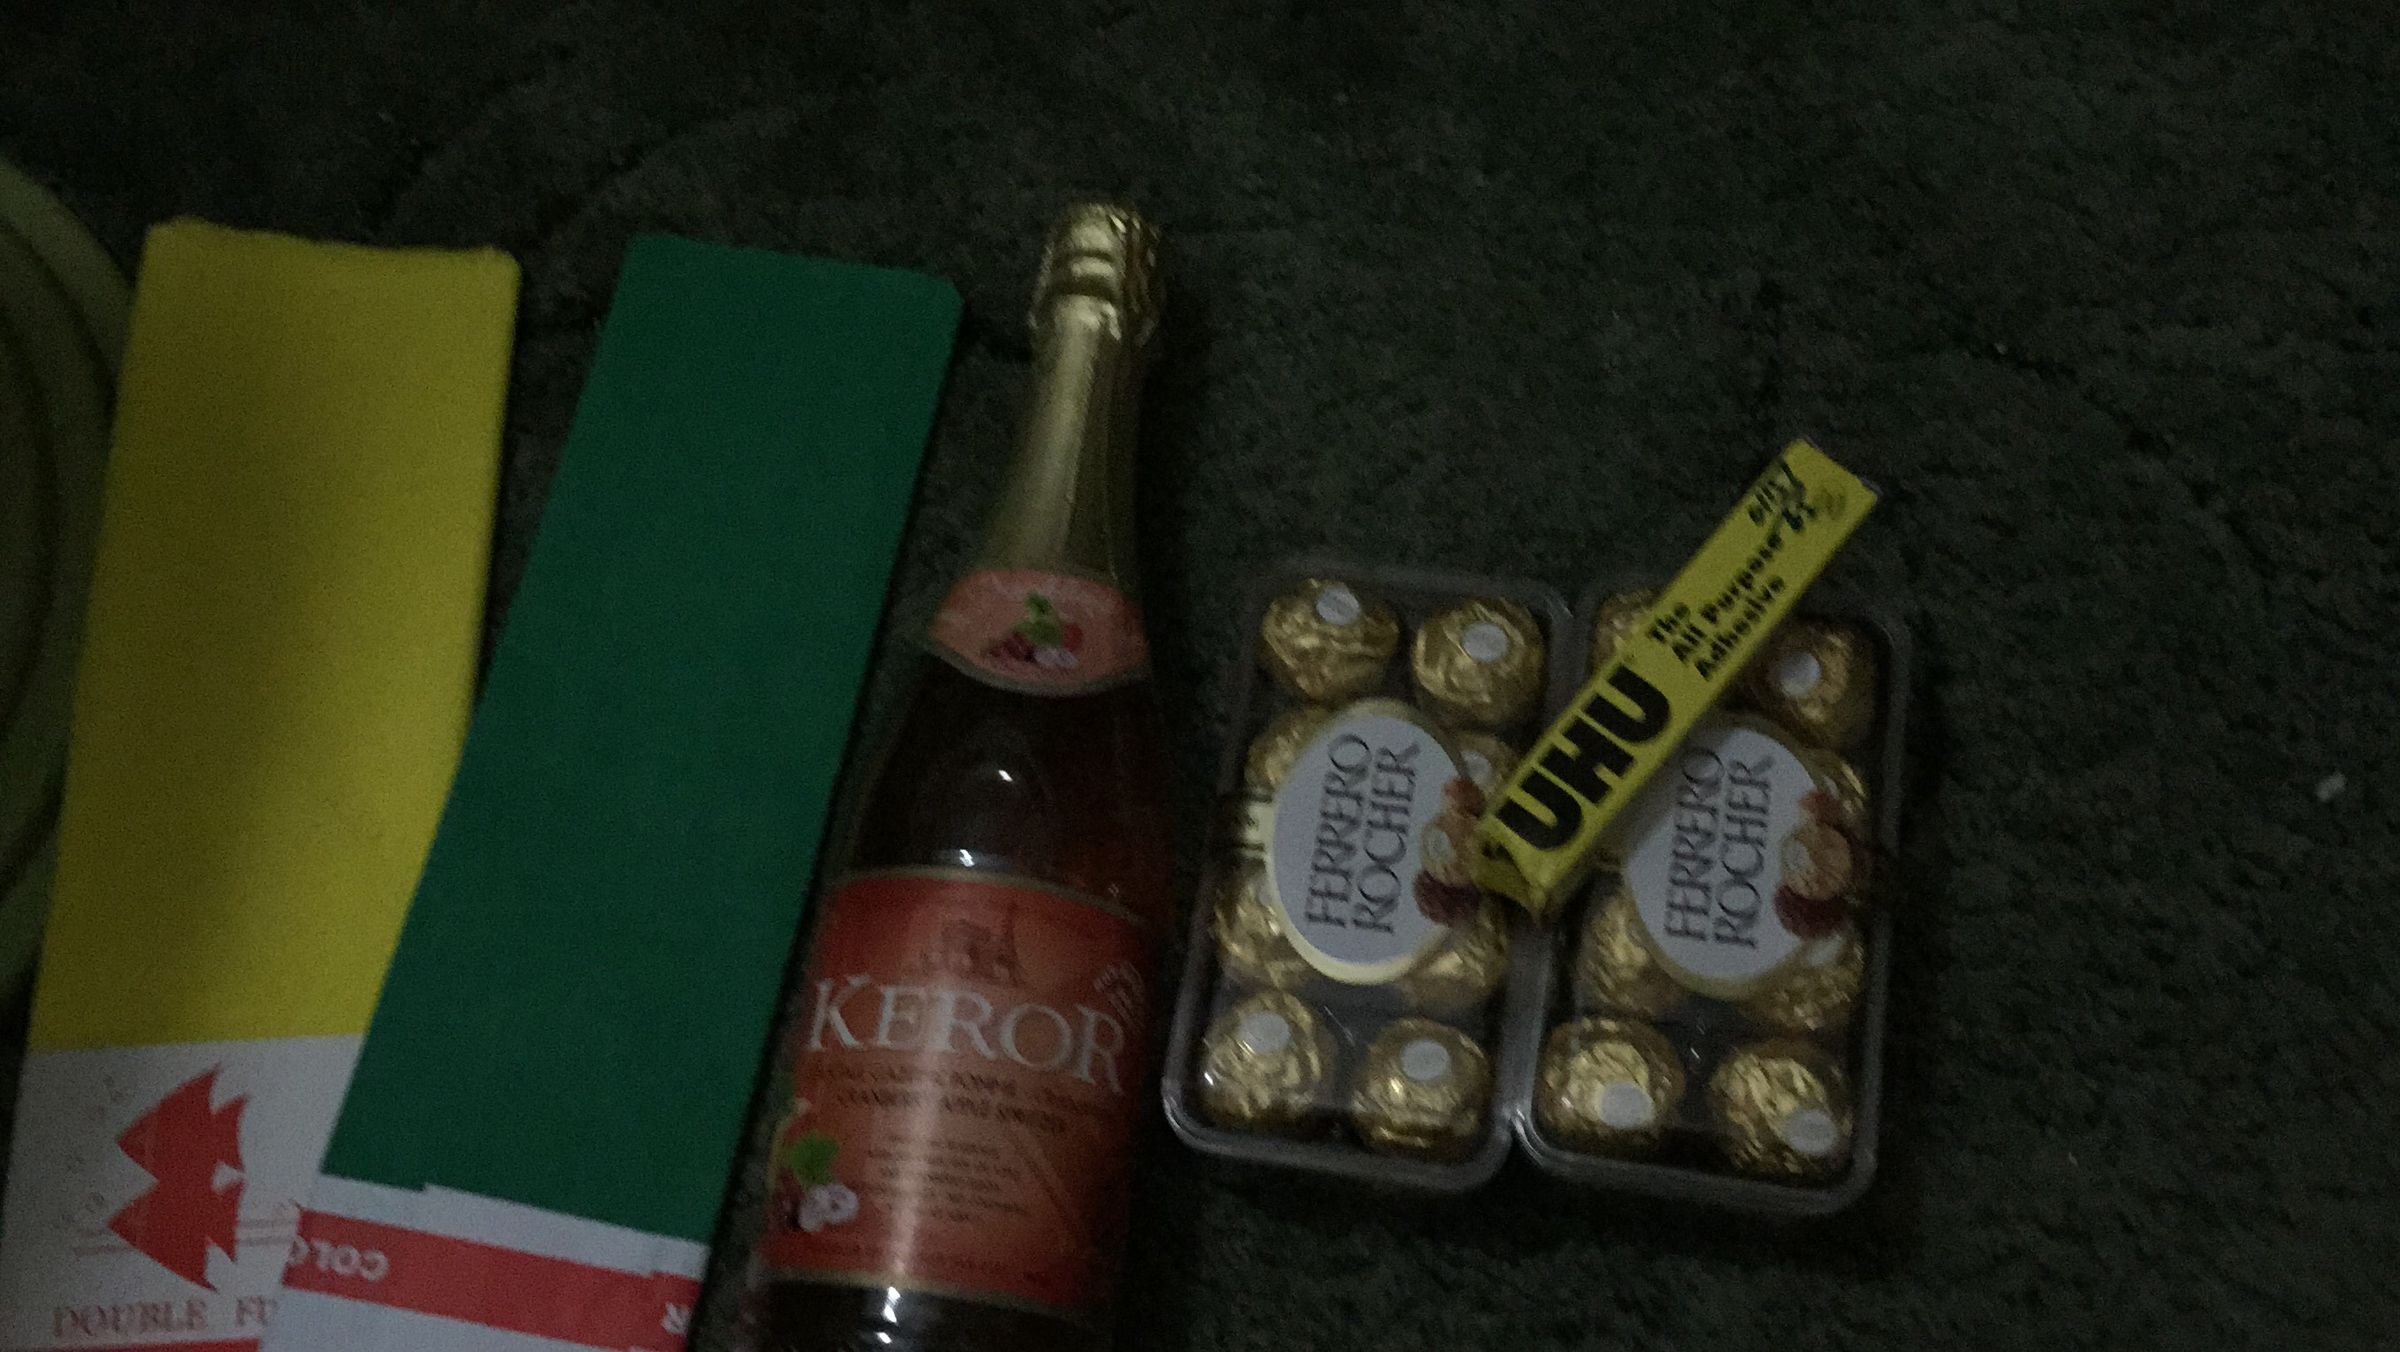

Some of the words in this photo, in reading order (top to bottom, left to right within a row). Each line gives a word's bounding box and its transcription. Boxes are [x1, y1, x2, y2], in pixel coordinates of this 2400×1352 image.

[1648, 602, 1692, 642] The
[1670, 622, 1708, 664] All
[1700, 532, 1783, 626] Purpose
[1694, 576, 1786, 681] Adhesive
[1307, 732, 1371, 929] FERRERO
[1352, 739, 1421, 935] ROCHER
[1498, 664, 1671, 851] UHU
[1663, 747, 1726, 943] FERRERO
[1713, 753, 1776, 949] ROCHER
[806, 972, 1124, 1097] KEROR
[52, 1298, 207, 1337] DOUBLE
